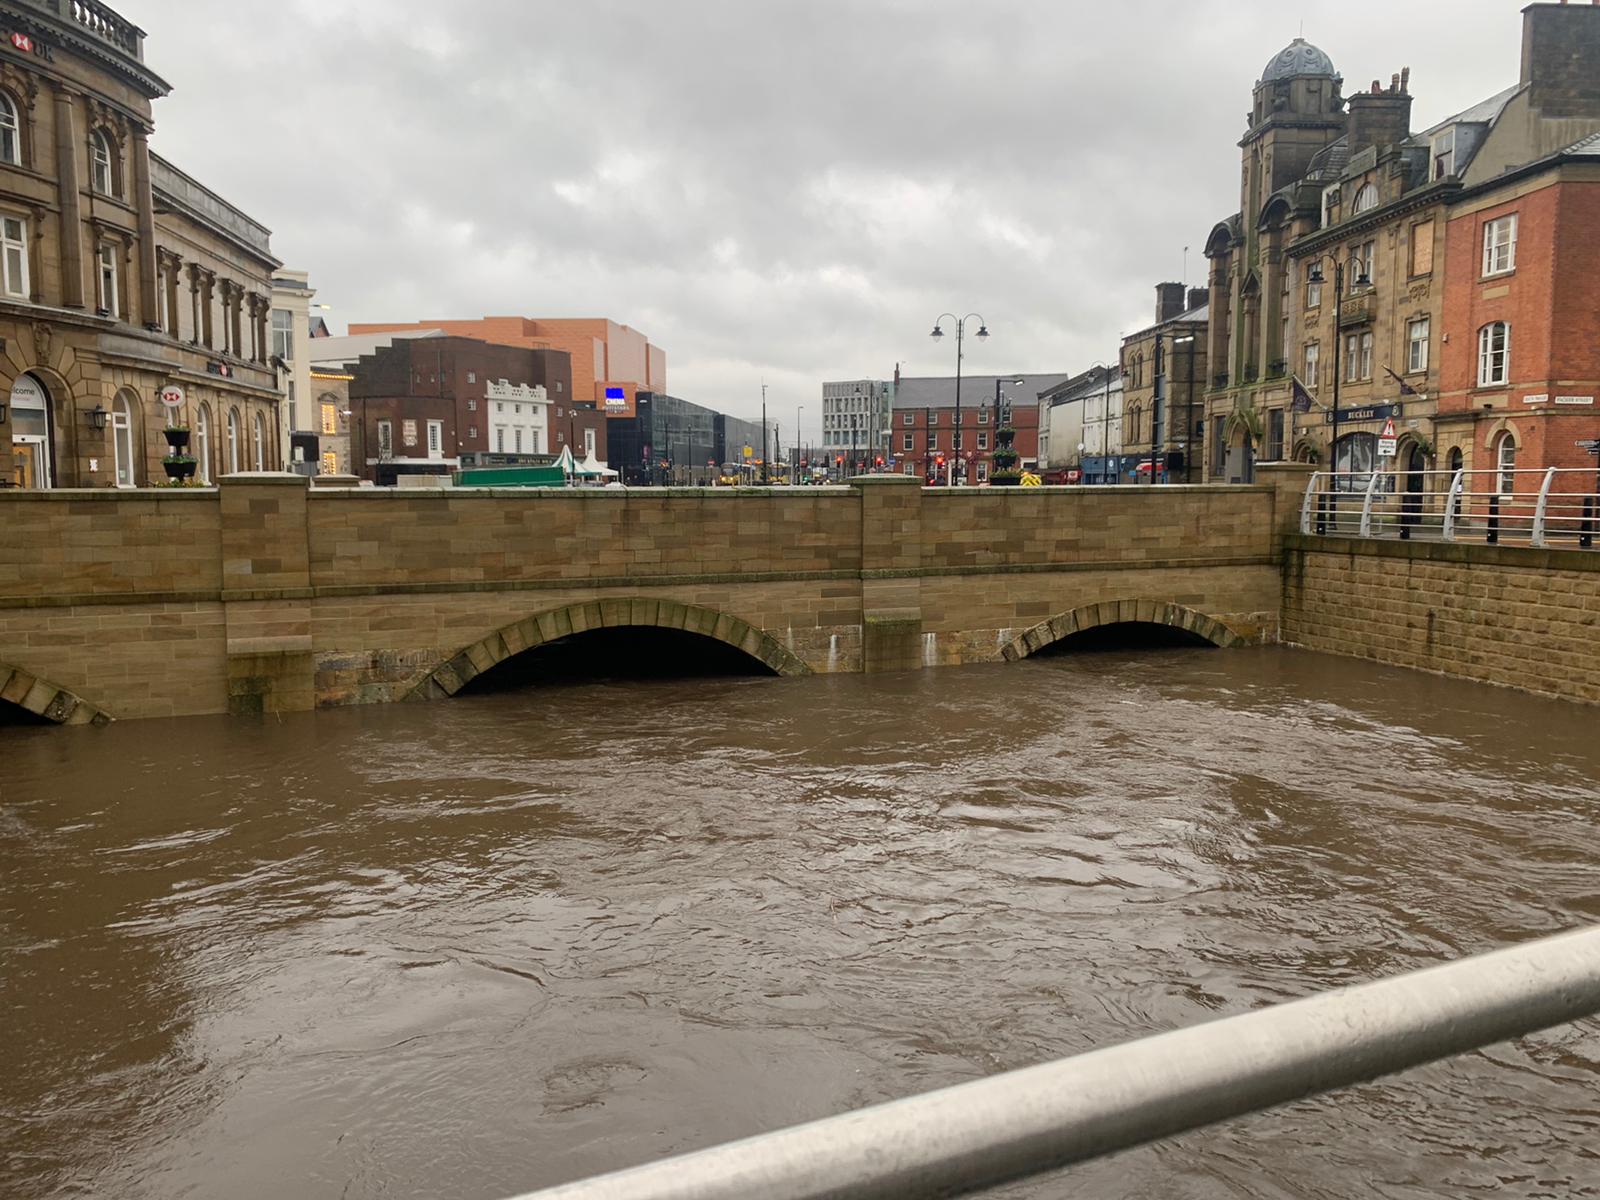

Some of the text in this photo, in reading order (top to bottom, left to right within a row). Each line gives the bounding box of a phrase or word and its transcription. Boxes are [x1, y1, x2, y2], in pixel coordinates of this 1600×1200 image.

[33, 41, 55, 64] UK
[13, 386, 35, 395] lcome
[1347, 410, 1374, 419] BUCKLEY
